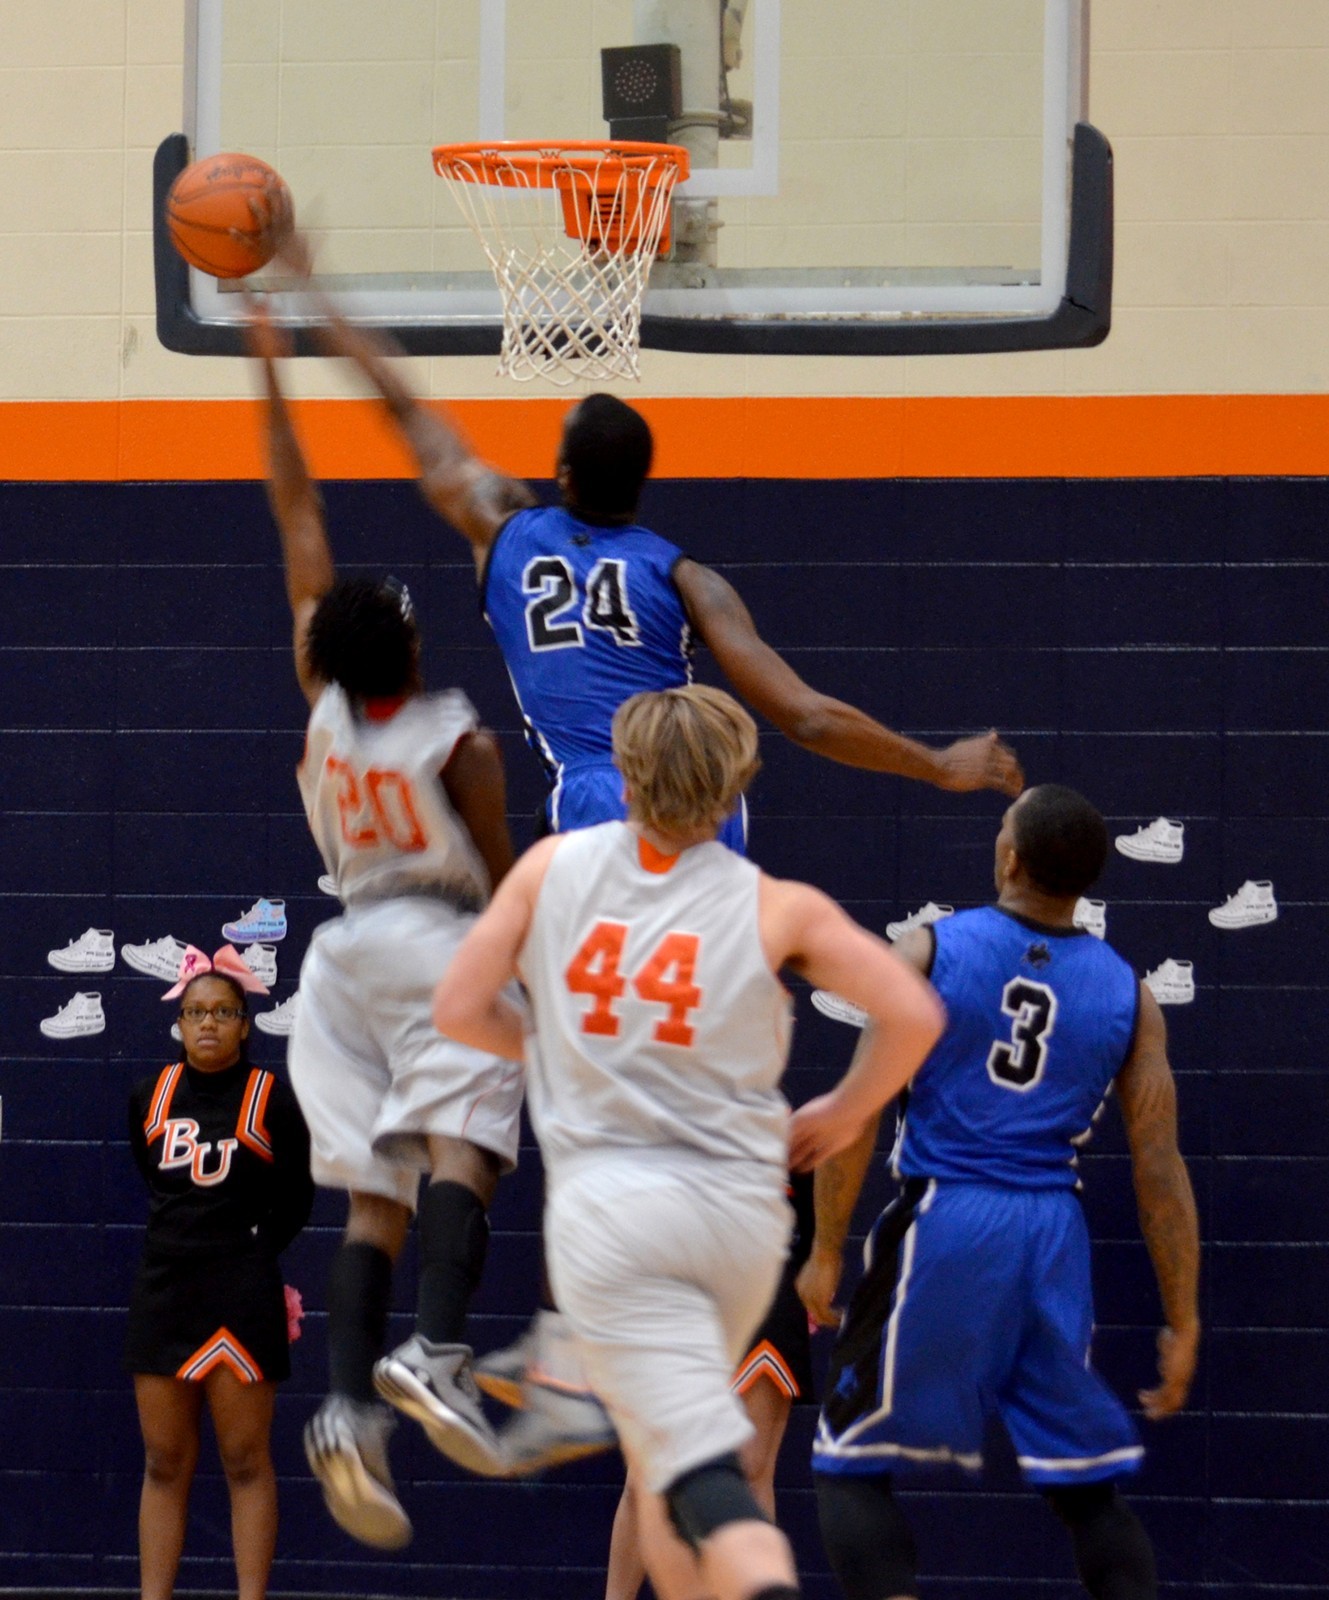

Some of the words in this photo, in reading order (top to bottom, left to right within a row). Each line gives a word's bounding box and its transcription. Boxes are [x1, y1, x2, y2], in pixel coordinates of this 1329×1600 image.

[522, 555, 643, 653] 24
[326, 755, 428, 853] 20
[564, 920, 703, 1048] 44
[986, 975, 1058, 1093] 3
[158, 1117, 238, 1187] BU
